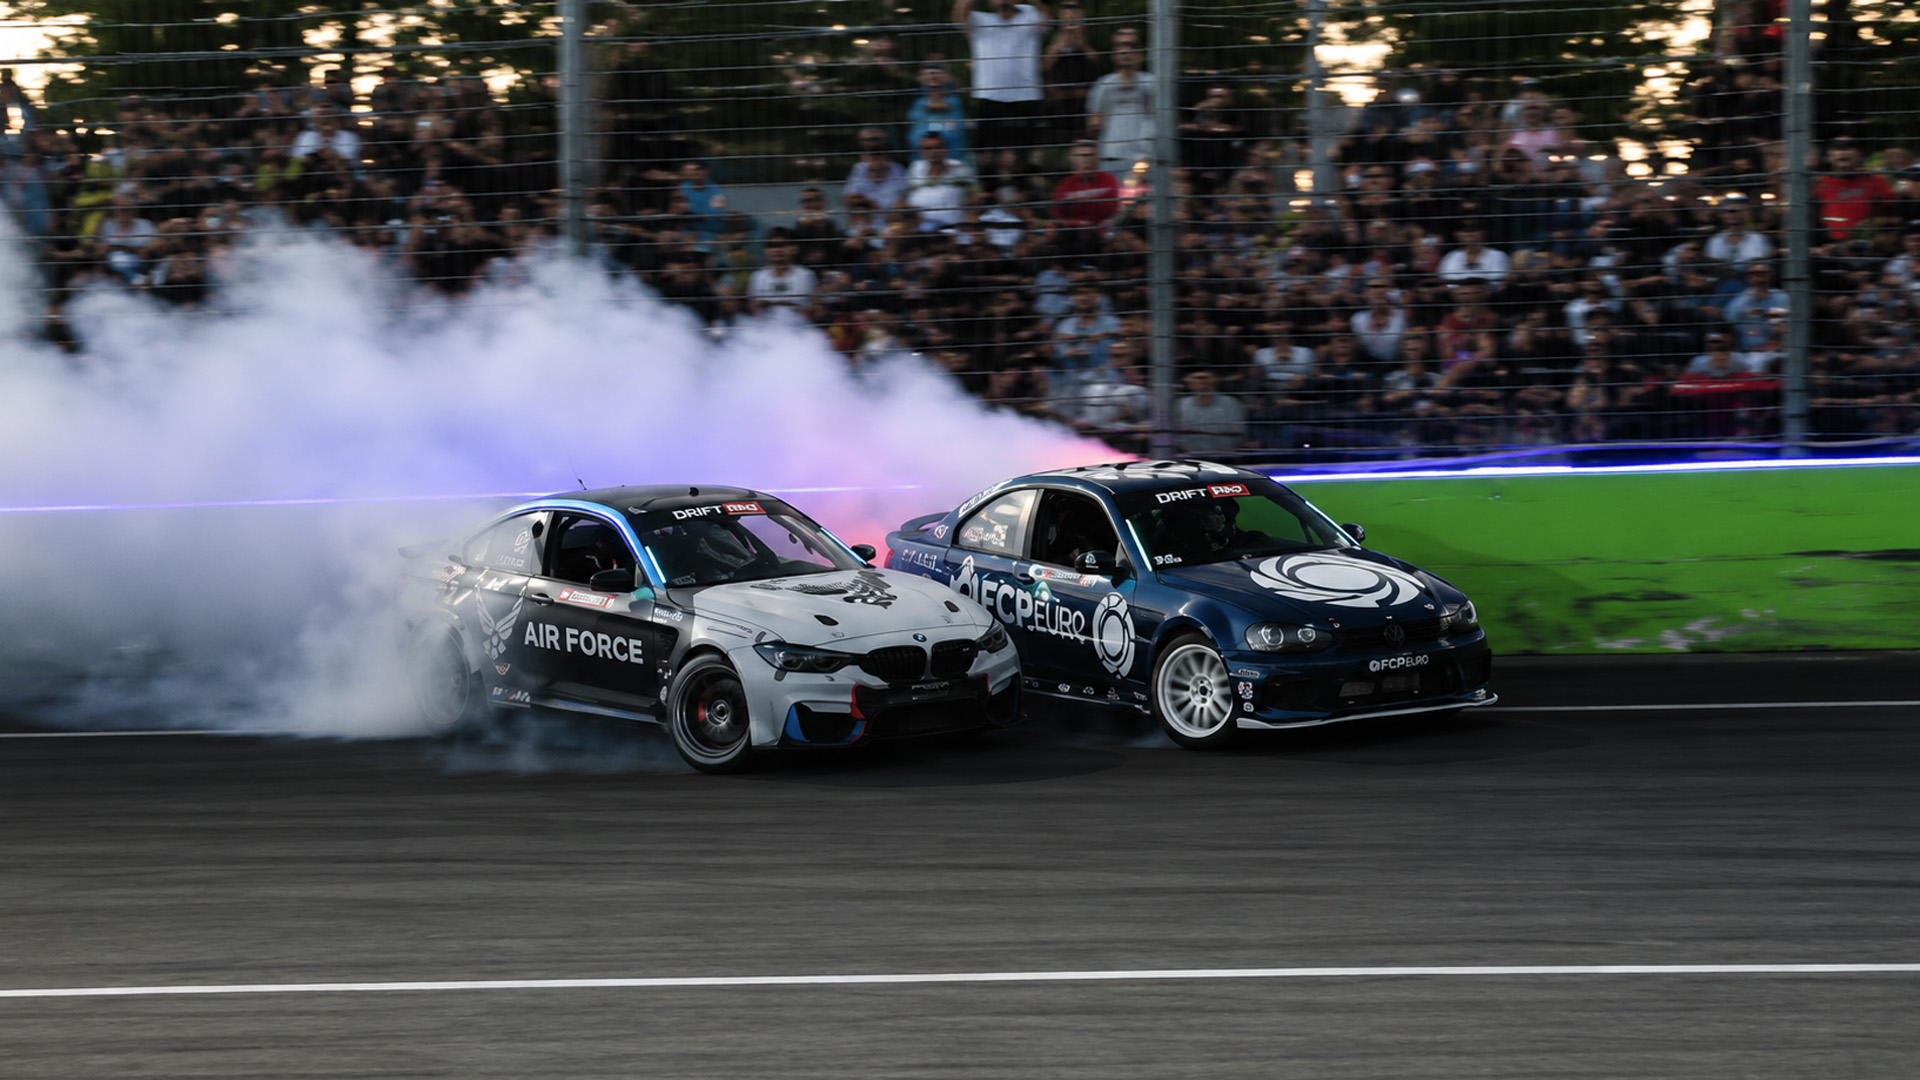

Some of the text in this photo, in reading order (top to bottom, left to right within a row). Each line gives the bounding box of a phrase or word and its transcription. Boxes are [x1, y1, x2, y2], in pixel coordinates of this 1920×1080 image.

[1155, 488, 1208, 504] DRIFT
[672, 505, 722, 520] DRIFT
[524, 621, 644, 664] AIR FORCE
